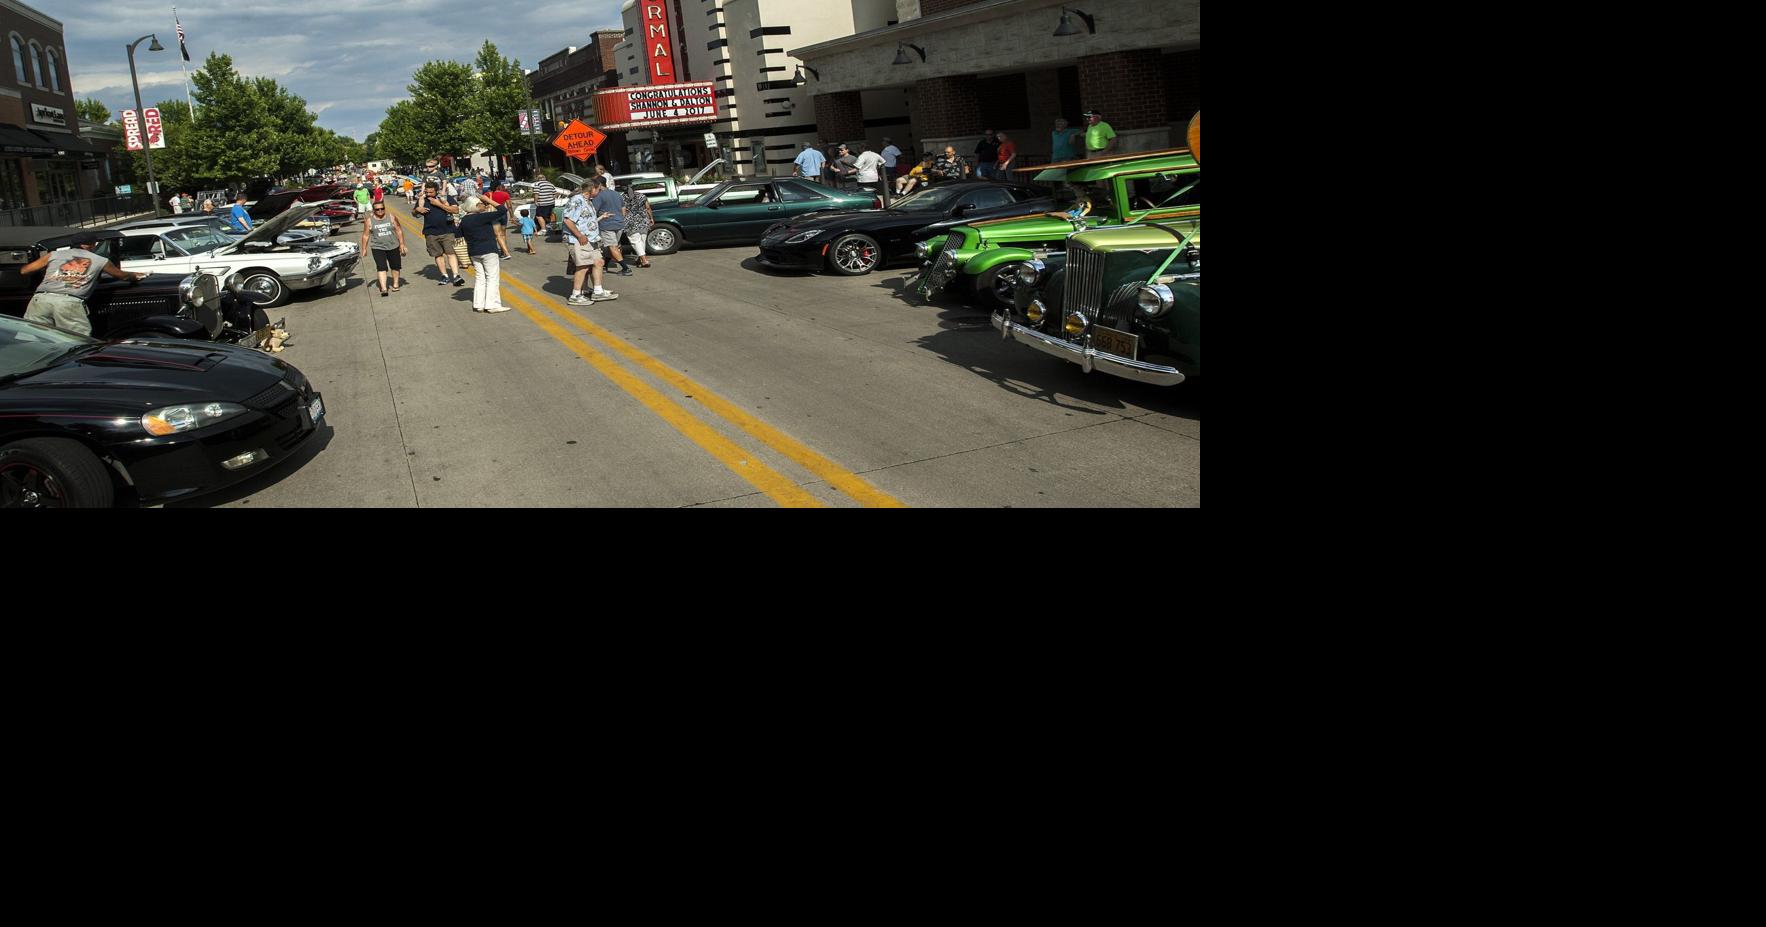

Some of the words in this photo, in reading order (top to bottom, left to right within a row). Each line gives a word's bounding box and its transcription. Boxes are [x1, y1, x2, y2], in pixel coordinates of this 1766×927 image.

[647, 0, 670, 76] RMAL
[630, 87, 709, 101] CONGRATULATIONS
[631, 100, 669, 111] SHANNON
[671, 99, 678, 108] &
[680, 96, 711, 106] DALTON
[643, 109, 668, 119] JUNE
[673, 108, 679, 116] 4
[685, 106, 705, 115] 2017
[145, 108, 161, 134] RED
[123, 110, 143, 148] SPREAD
[563, 130, 594, 141] DETOUR
[567, 139, 594, 149] AHEAD
